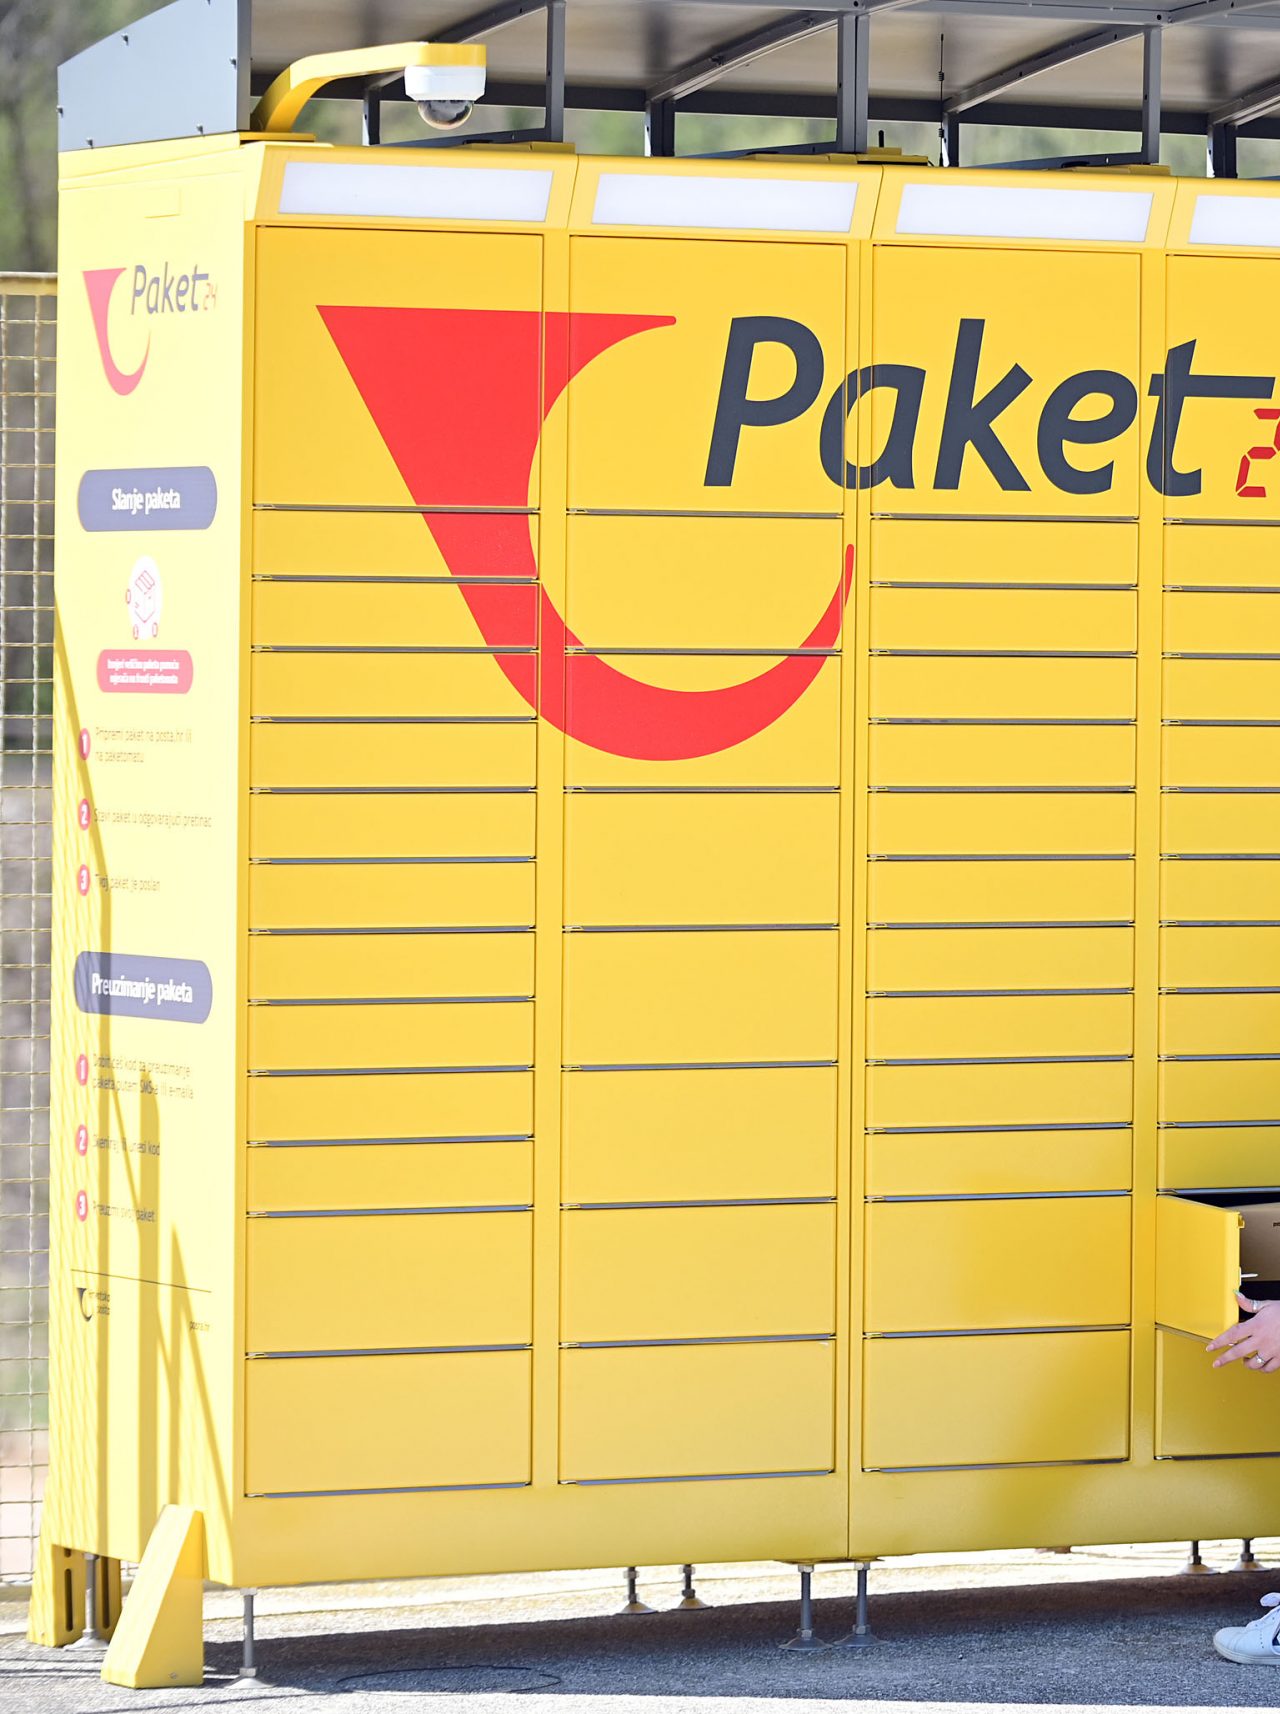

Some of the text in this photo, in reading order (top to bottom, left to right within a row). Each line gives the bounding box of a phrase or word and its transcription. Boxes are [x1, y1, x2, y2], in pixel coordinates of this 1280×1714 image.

[130, 261, 209, 315] Paket
[703, 315, 1276, 498] Paket
[112, 486, 180, 515] Slanje paketa
[82, 734, 88, 753] 1
[81, 805, 88, 824] 2
[81, 871, 88, 890] 3
[91, 973, 193, 1006] Preuzimanje paketa
[79, 1059, 85, 1080] 1
[79, 1130, 85, 1150] 2
[79, 1196, 85, 1216] 3
